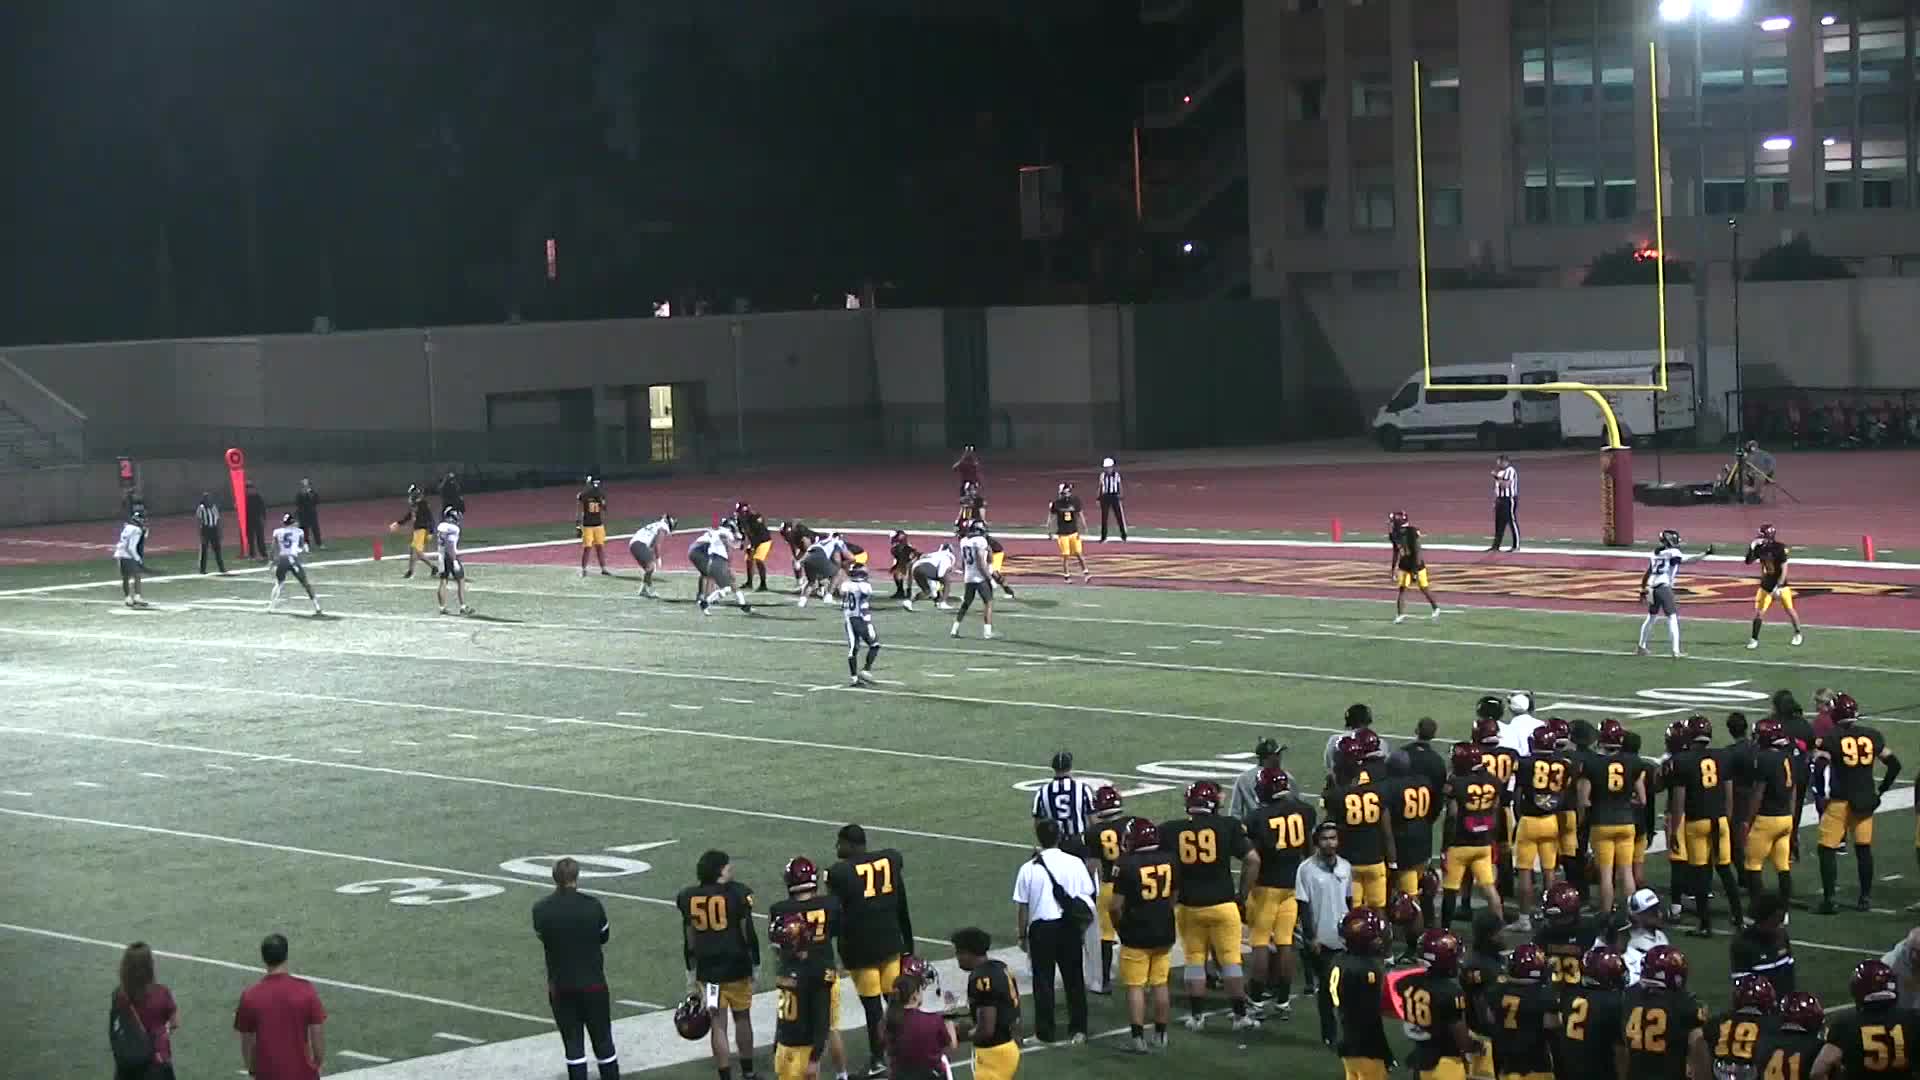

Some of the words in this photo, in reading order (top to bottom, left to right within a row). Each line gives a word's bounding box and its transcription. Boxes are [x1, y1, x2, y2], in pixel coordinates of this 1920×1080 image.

[1840, 735, 1874, 767] 93
[1533, 761, 1567, 793] 83
[1607, 762, 1625, 792] 6
[1700, 757, 1718, 789] 8
[1055, 794, 1072, 819] S
[1344, 792, 1381, 825] 86
[1403, 785, 1431, 819] 60
[1178, 828, 1217, 864] 69
[1268, 813, 1306, 850] 70
[855, 857, 894, 897] 77
[1139, 864, 1174, 900] 57
[689, 895, 728, 931] 50
[805, 908, 827, 944] 7
[1566, 997, 1590, 1041] 2
[1626, 1006, 1668, 1052] 42
[1763, 1048, 1801, 1080] 41
[1860, 1024, 1908, 1072] 51
